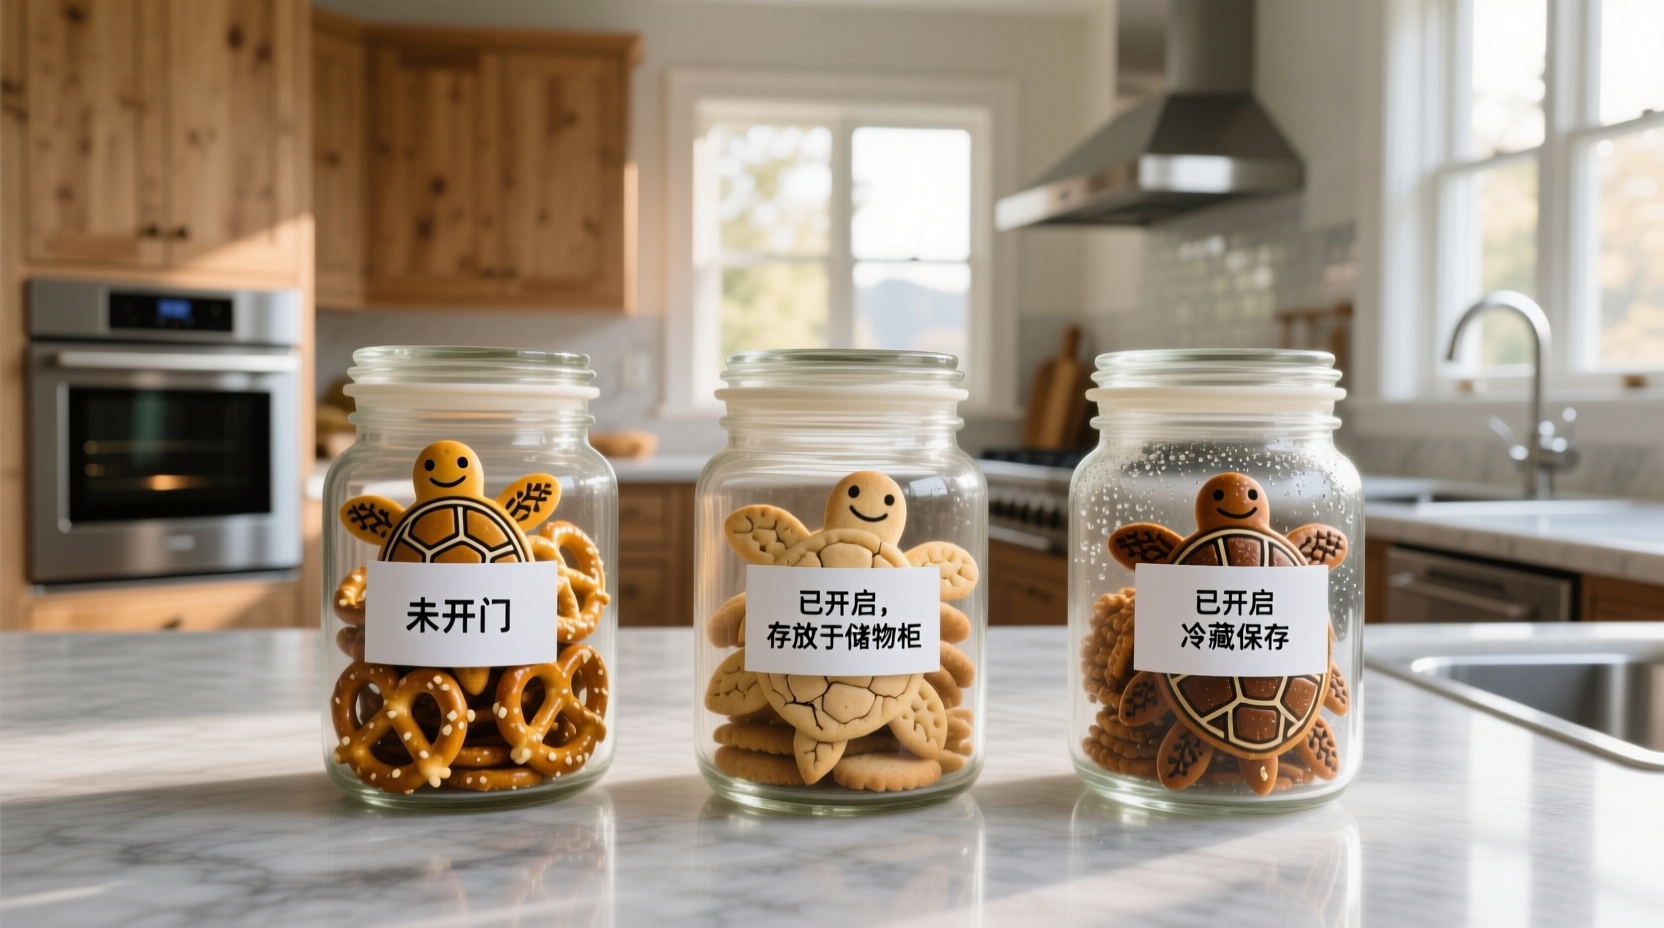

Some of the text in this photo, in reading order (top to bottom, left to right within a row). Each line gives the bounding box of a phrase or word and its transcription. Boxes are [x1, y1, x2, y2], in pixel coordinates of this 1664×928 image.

[406, 597, 511, 634] 未开门
[799, 589, 889, 617] 已开启，
[1196, 589, 1274, 616] 已开启
[1181, 621, 1290, 651] 冷藏保存
